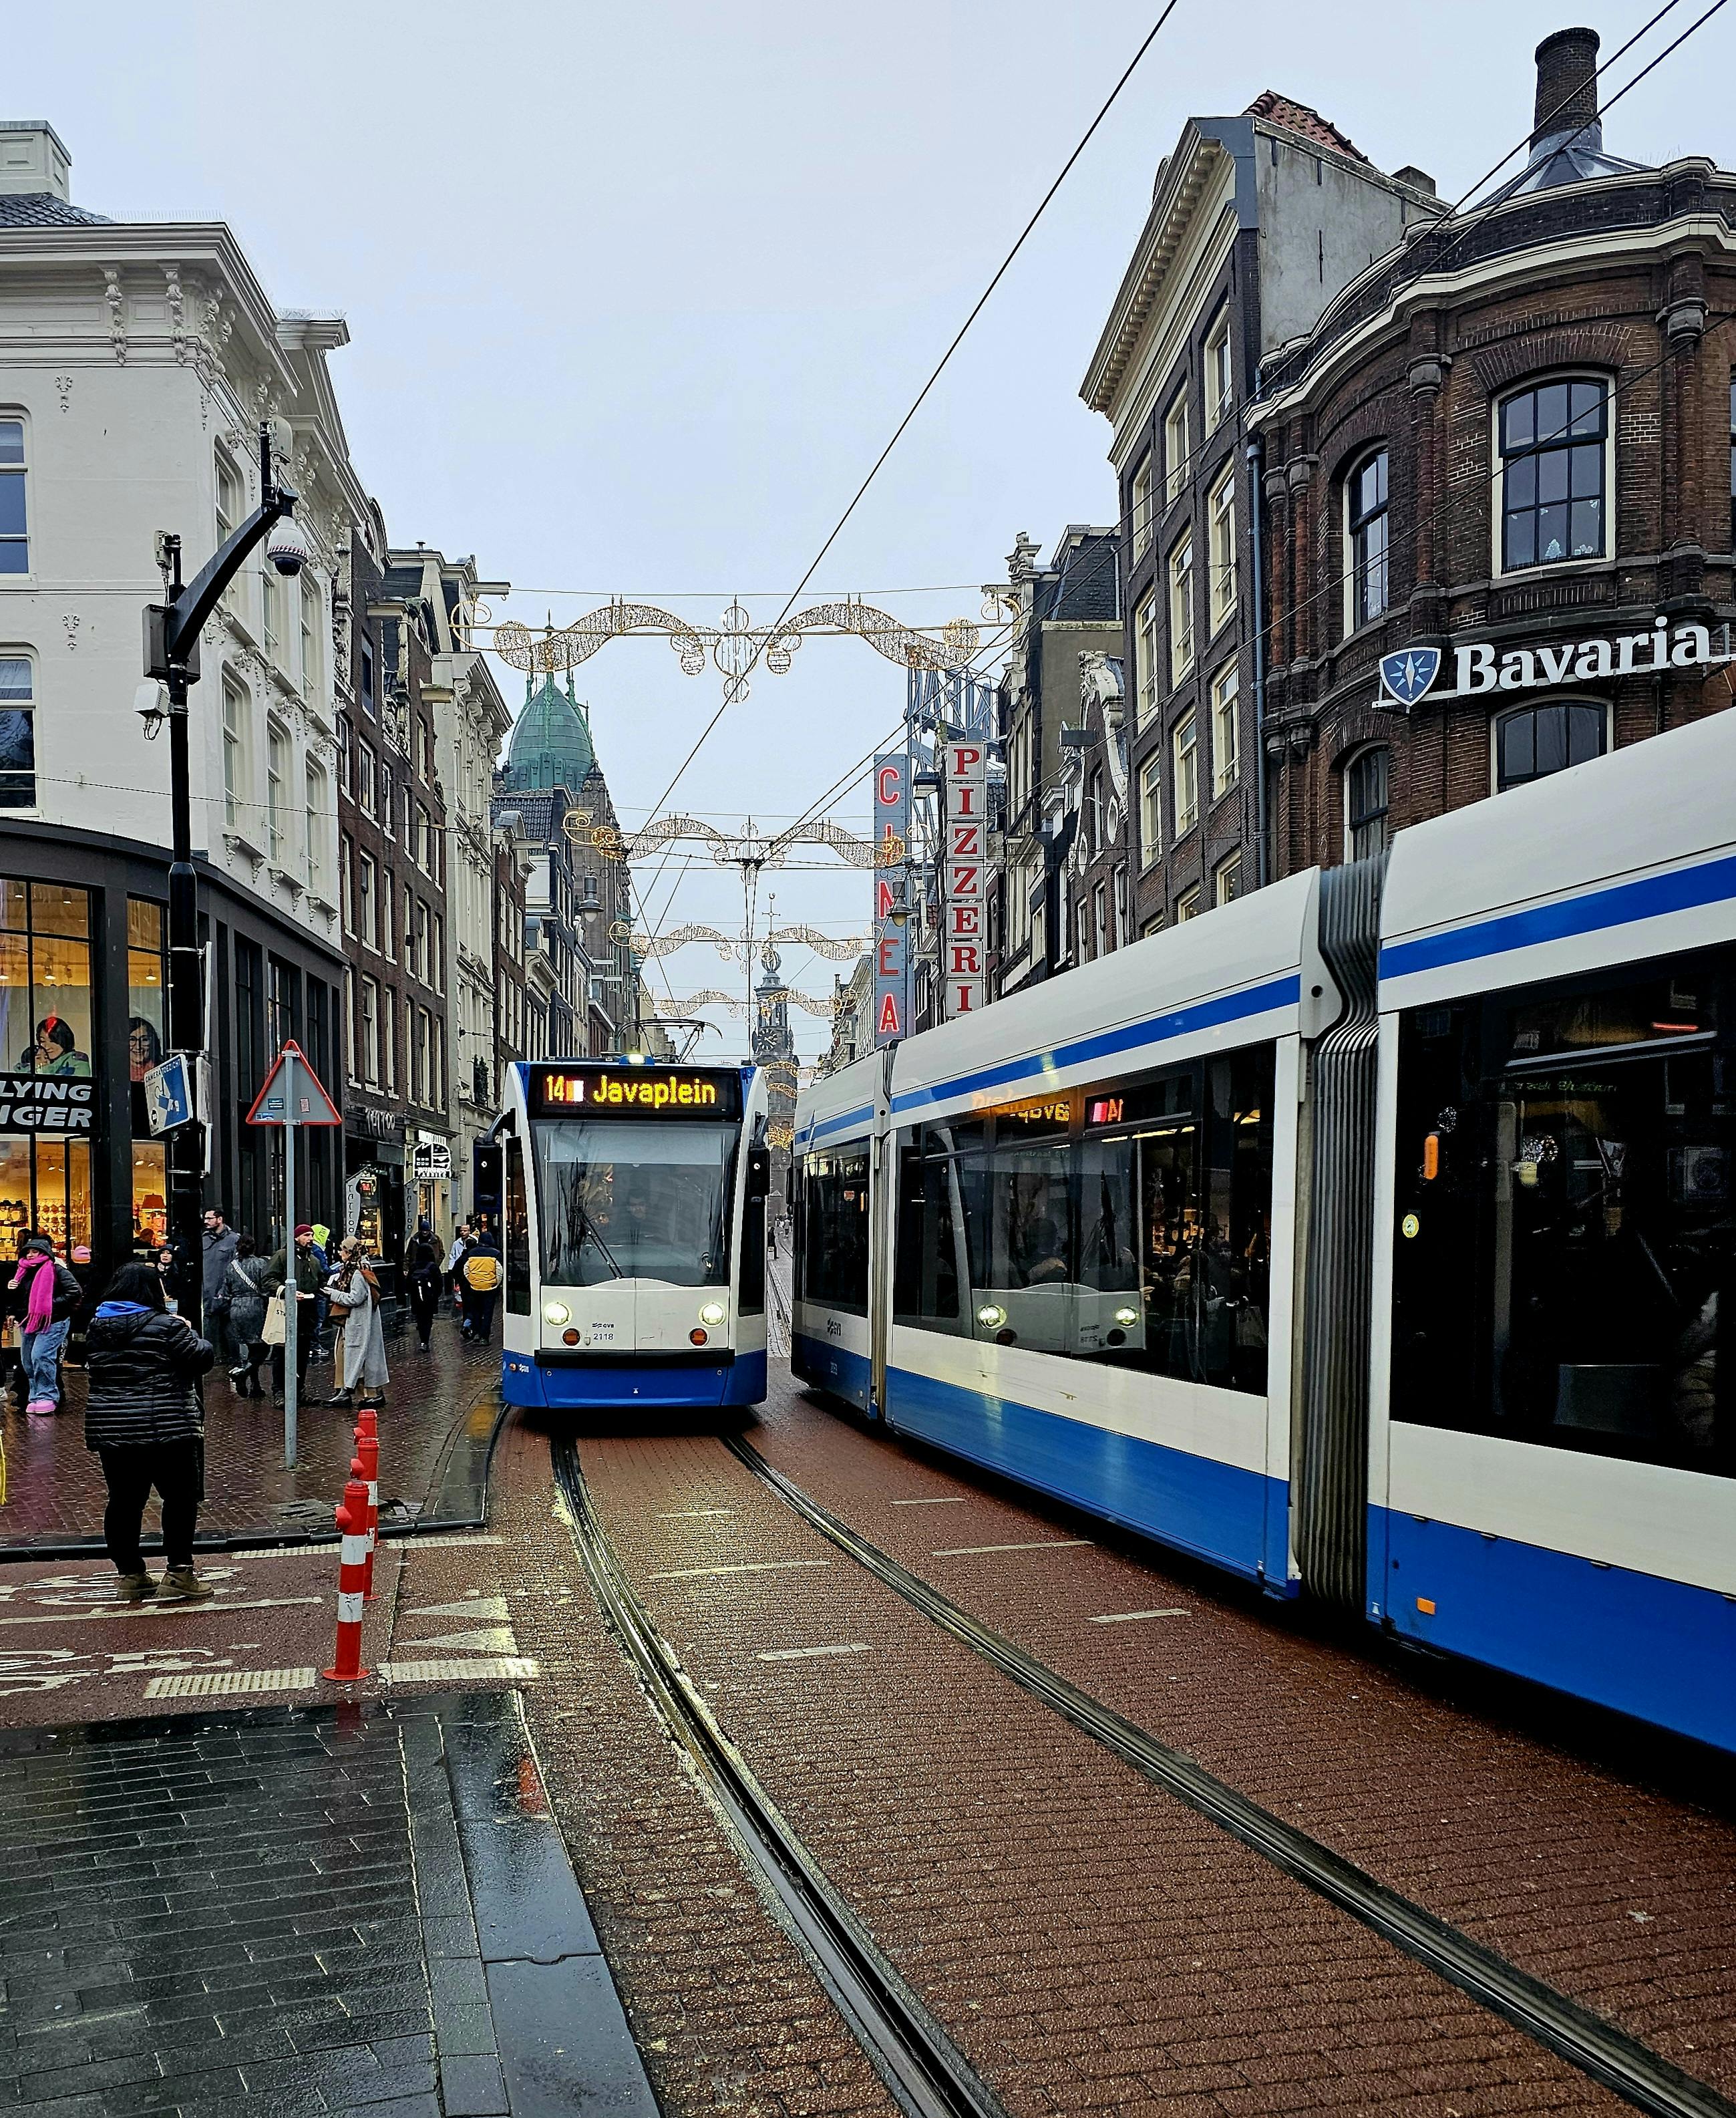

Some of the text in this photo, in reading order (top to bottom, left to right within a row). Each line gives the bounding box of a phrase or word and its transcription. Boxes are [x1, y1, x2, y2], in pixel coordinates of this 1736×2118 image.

[1453, 615, 1713, 696] Bavaria
[546, 1074, 715, 1109] 14 Javaplein
[347, 1184, 355, 1233] TATTOO
